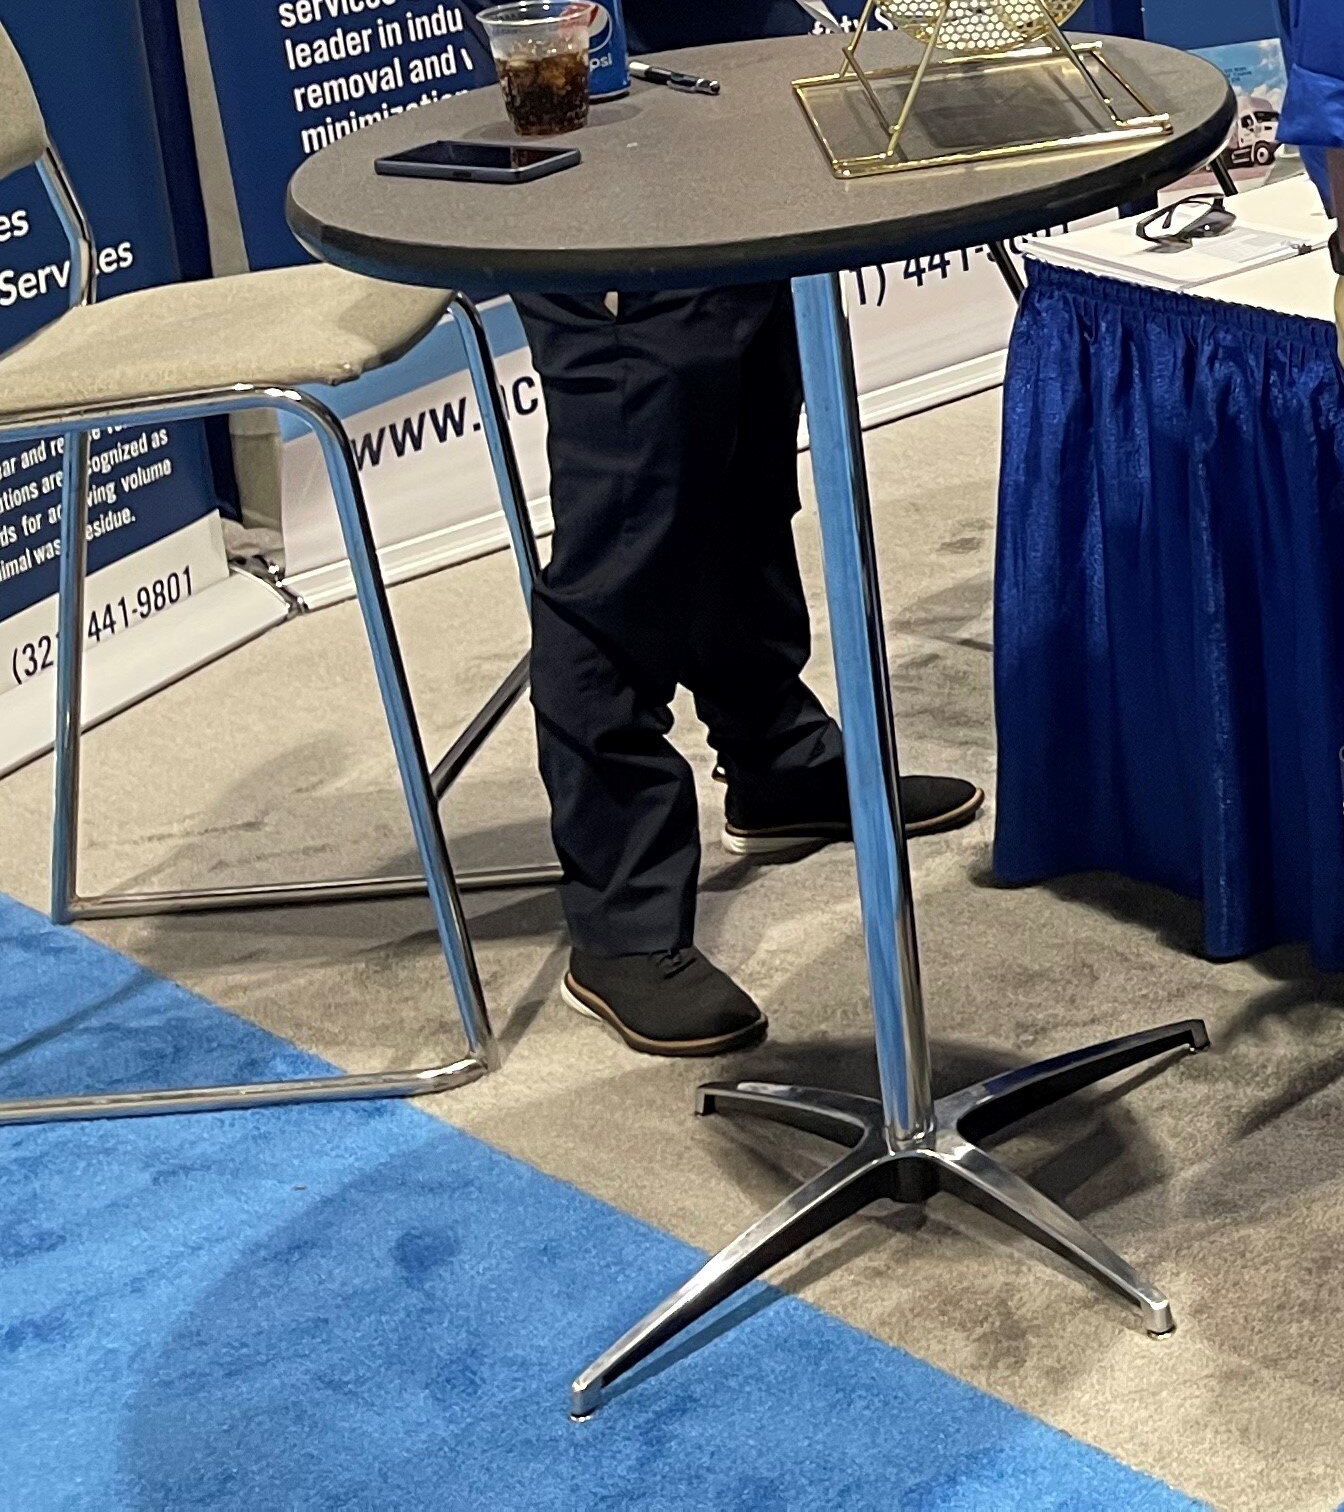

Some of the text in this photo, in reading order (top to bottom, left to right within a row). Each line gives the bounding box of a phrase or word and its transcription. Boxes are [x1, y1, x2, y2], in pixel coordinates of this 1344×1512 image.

[285, 5, 463, 70] leader in indu
[293, 57, 403, 112] removal
[409, 44, 456, 86] and
[21, 439, 47, 469] and
[88, 431, 149, 474] ognized
[151, 428, 168, 449] as
[21, 512, 42, 537] for
[120, 458, 172, 493] volume
[0, 547, 32, 582] imal
[85, 507, 136, 541] esidue.
[87, 565, 193, 643] 441-9801
